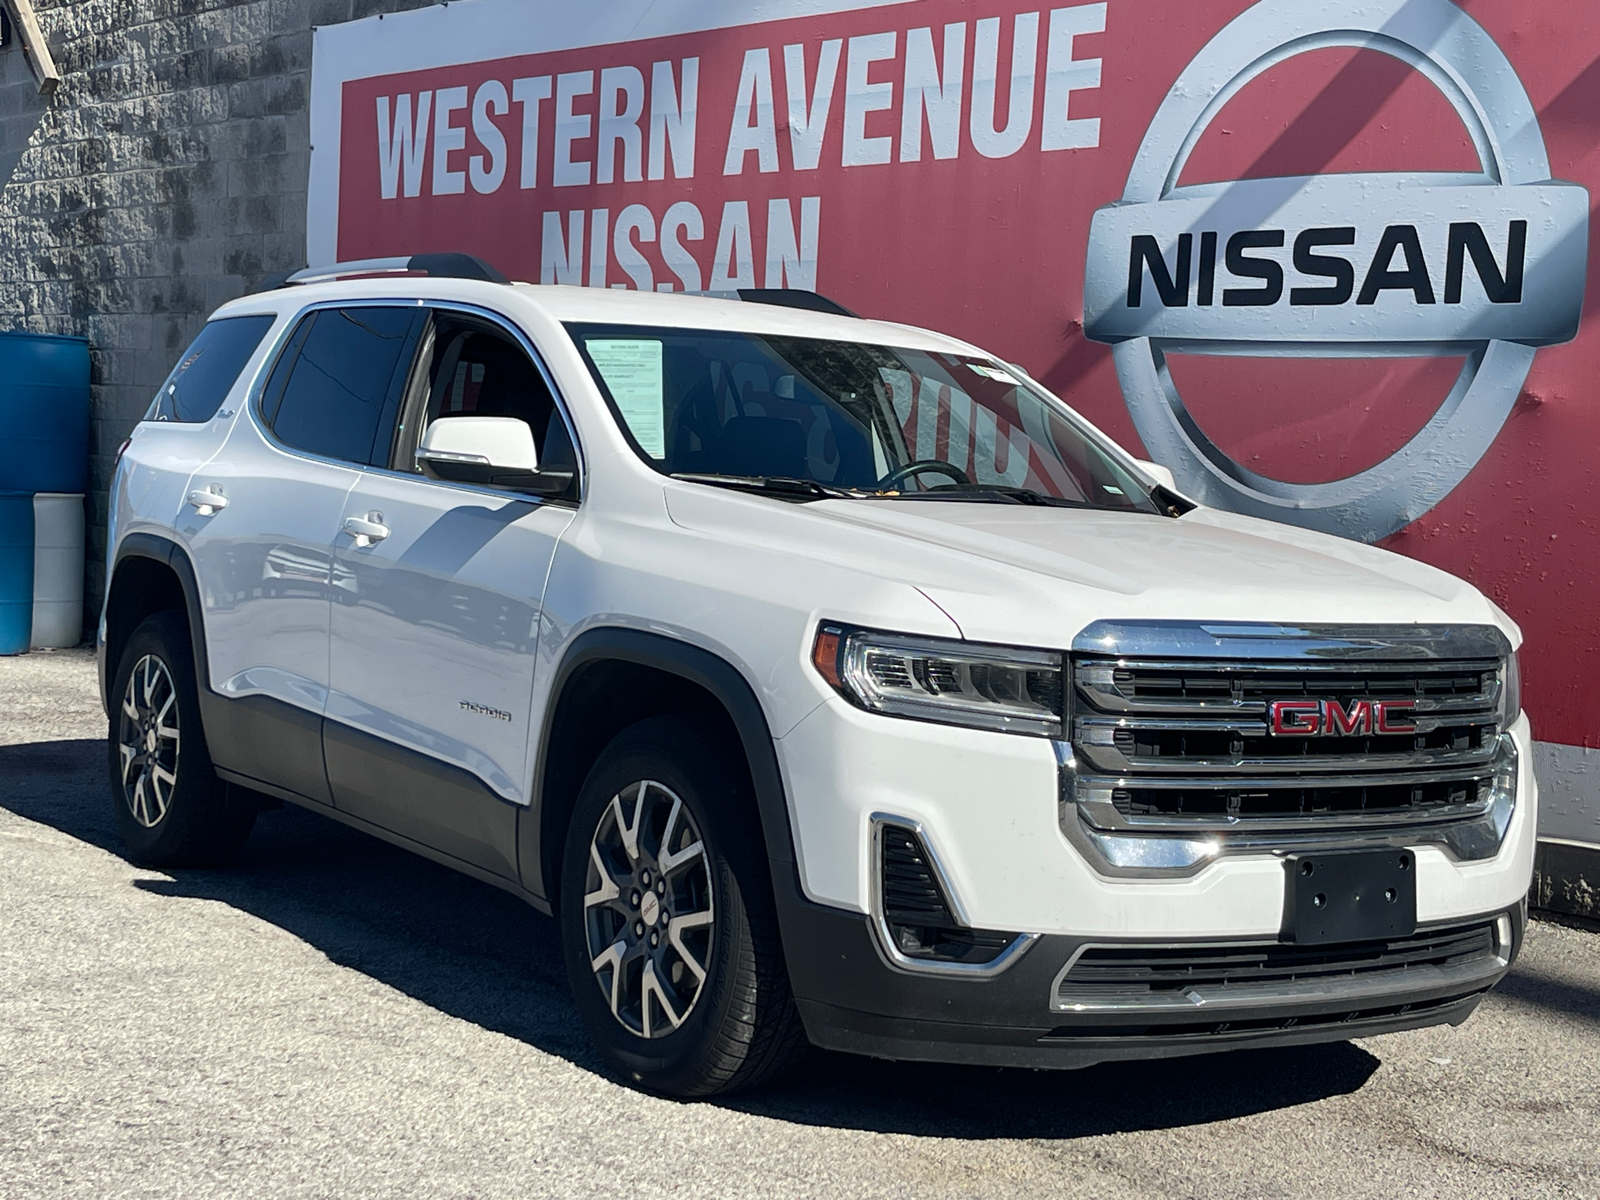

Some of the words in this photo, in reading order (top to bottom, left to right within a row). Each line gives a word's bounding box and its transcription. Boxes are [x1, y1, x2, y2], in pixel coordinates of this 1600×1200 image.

[376, 57, 700, 200] WESTERN
[723, 2, 1108, 177] AVENUE
[540, 196, 821, 293] NISSAN
[1127, 220, 1527, 307] NISSAN
[459, 700, 512, 722] ACADIA
[1268, 699, 1416, 736] GMC
